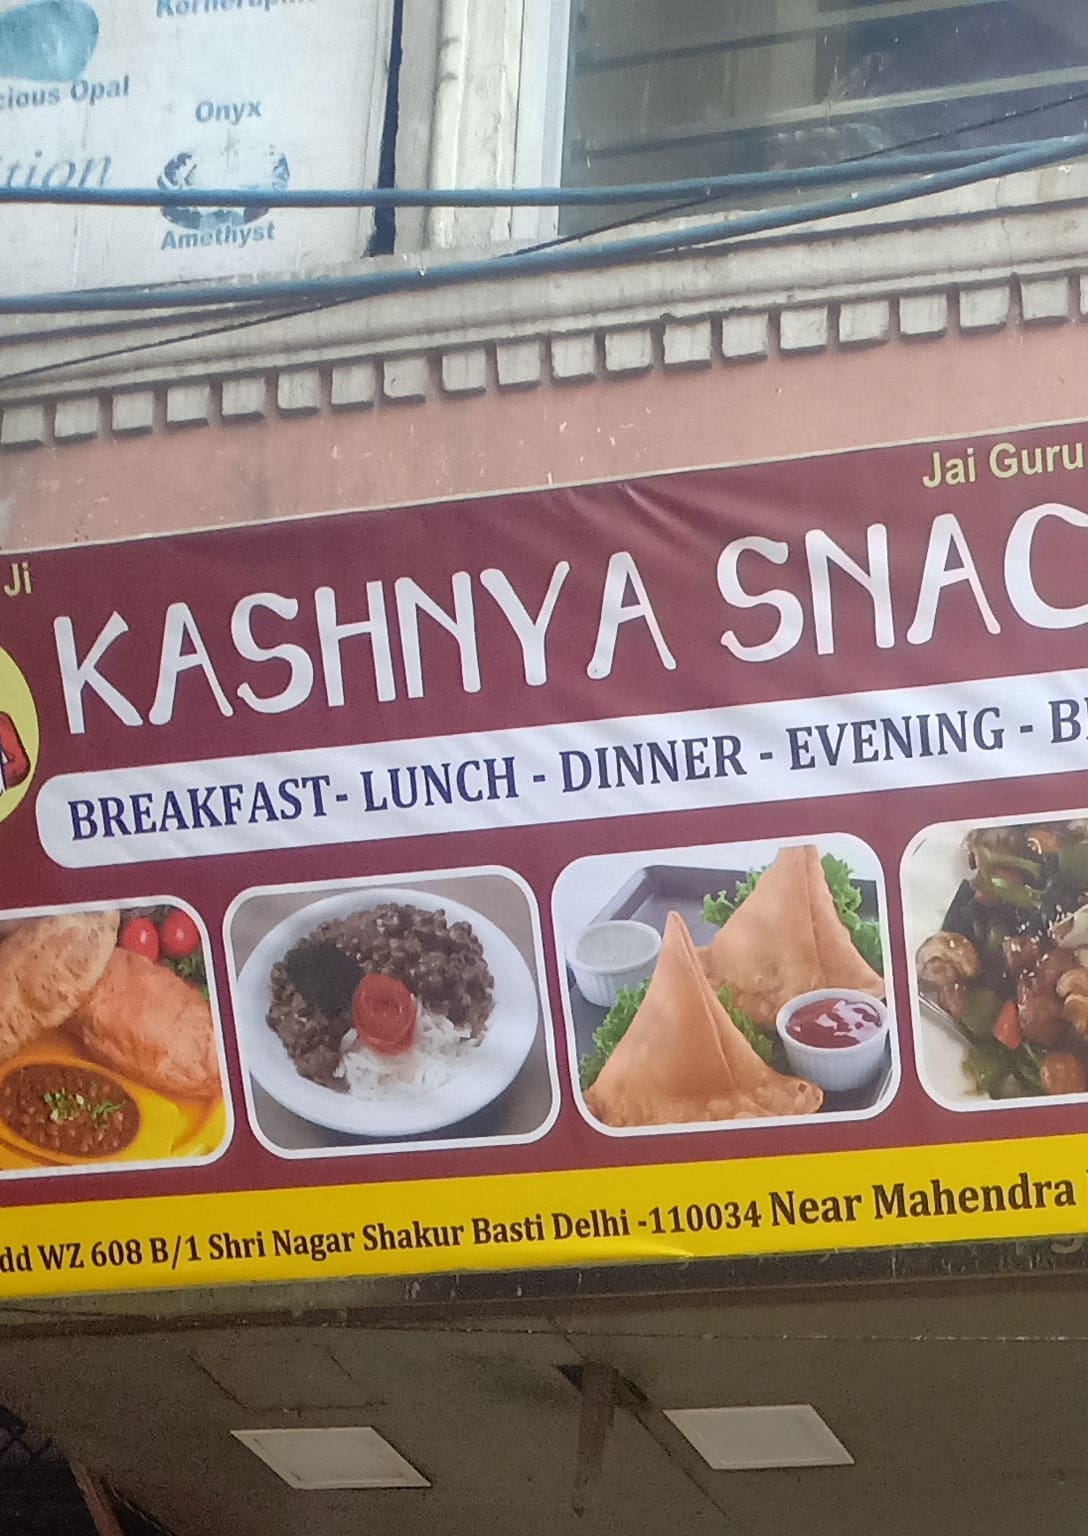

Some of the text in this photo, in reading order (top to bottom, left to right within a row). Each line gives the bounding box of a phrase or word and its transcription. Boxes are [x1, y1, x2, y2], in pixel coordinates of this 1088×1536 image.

[70, 74, 130, 106] Opal
[195, 99, 262, 126] Onyx
[0, 149, 113, 188] tion
[160, 221, 276, 251] Amethyst
[922, 447, 977, 488] Jai
[988, 438, 1085, 480] Guru
[4, 561, 33, 597] Ji
[53, 551, 678, 734] KASHNYA
[362, 756, 520, 813] LUNCH
[559, 734, 748, 795] DINNER
[785, 707, 1003, 771] EVENING
[37, 1242, 85, 1271] WZ
[91, 1239, 143, 1267] 608
[149, 1235, 203, 1272] B/1
[208, 1230, 268, 1262] Shri
[273, 1226, 357, 1263] Nagar
[362, 1220, 465, 1252] Shakur
[472, 1212, 545, 1245] Basti
[552, 1206, 631, 1240] Delhi
[636, 1200, 762, 1236] -110034
[769, 1188, 863, 1228] Near
[871, 1172, 1075, 1222] Mahendra
